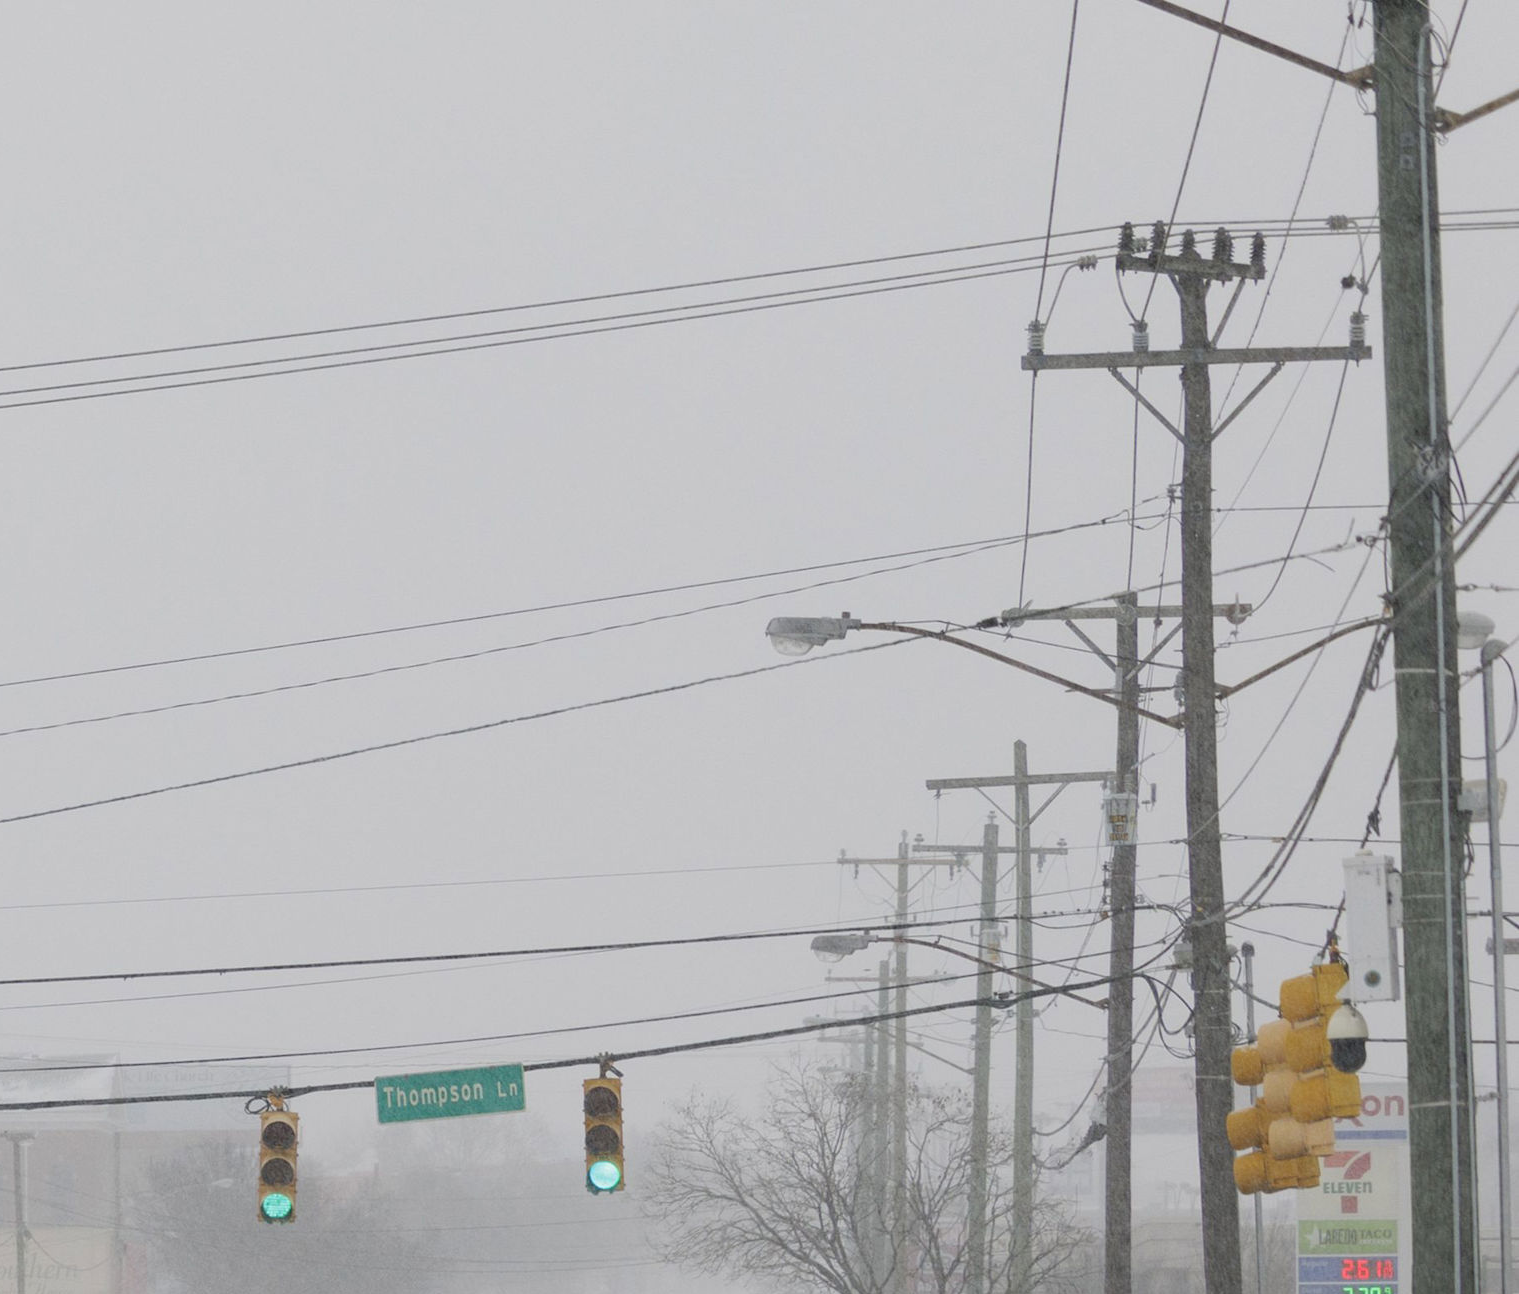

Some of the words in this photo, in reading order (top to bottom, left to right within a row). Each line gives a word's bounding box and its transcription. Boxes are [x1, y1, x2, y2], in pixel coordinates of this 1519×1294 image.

[383, 1084, 484, 1108] Thompson
[497, 1081, 519, 1098] Ln
[1318, 1228, 1357, 1246] LAREDO
[1359, 1229, 1393, 1240] TACO
